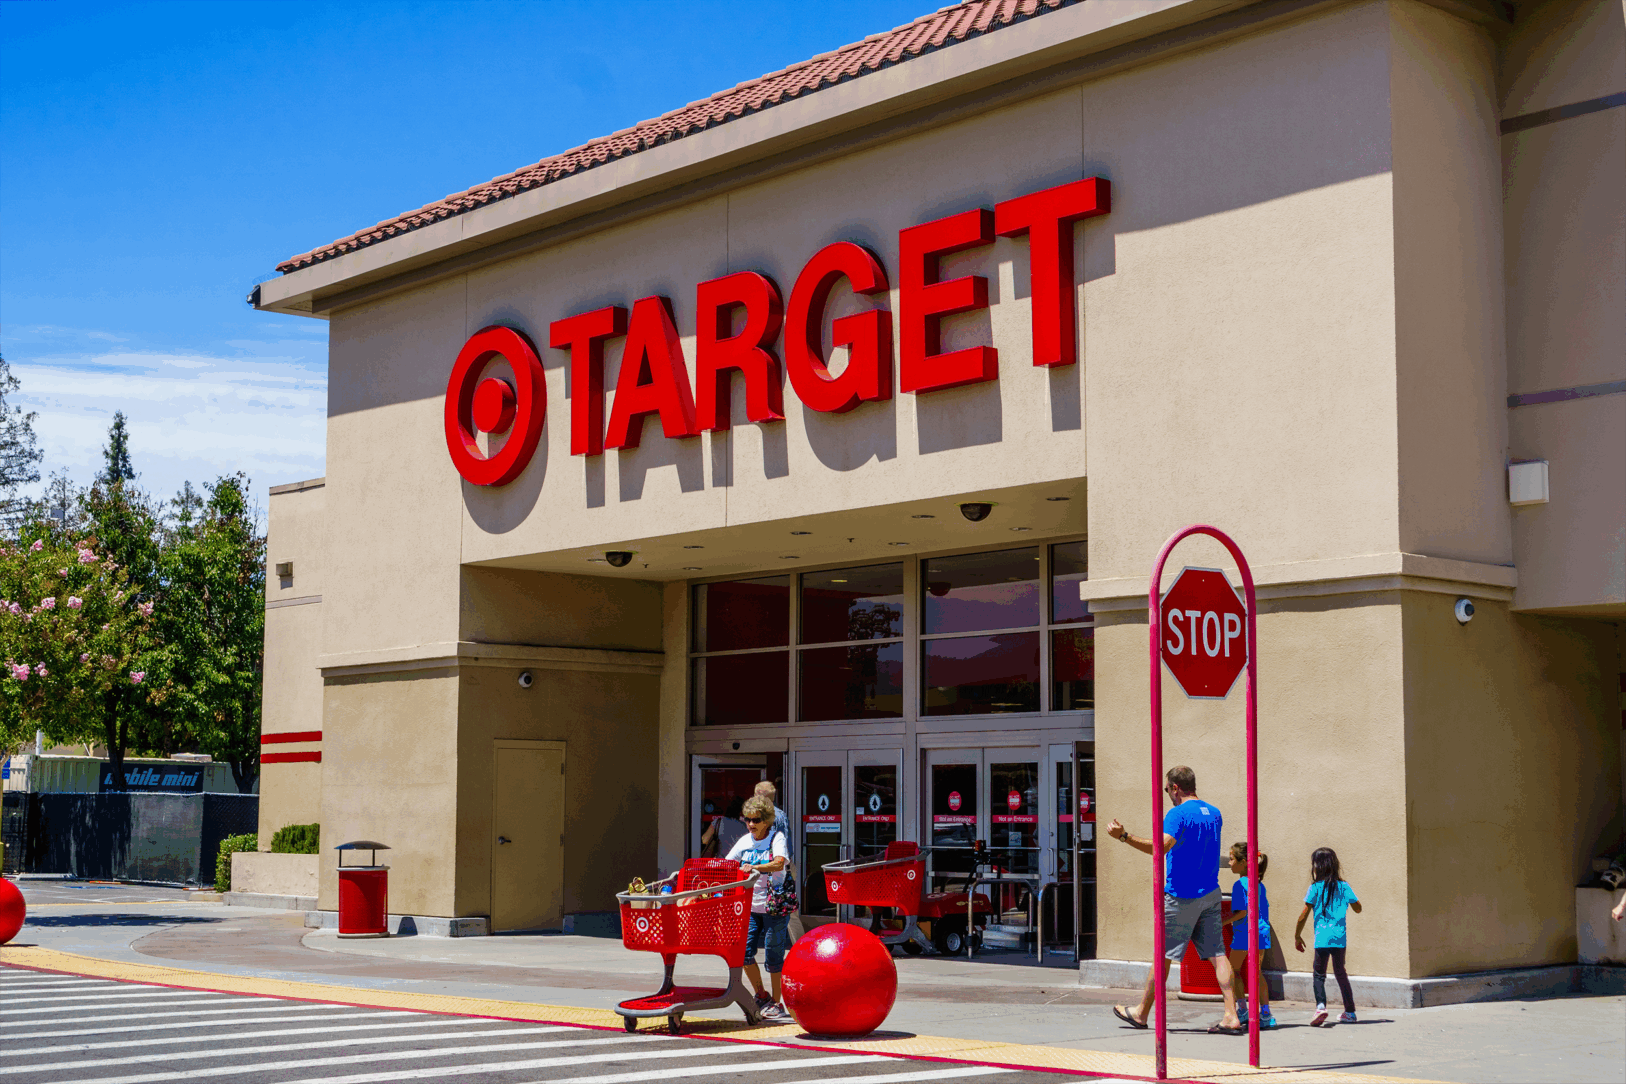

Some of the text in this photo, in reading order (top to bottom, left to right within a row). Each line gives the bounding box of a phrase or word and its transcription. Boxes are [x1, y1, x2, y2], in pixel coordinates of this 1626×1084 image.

[550, 176, 1111, 457] TARGET
[1166, 608, 1241, 657] STOP
[161, 771, 199, 786] mini
